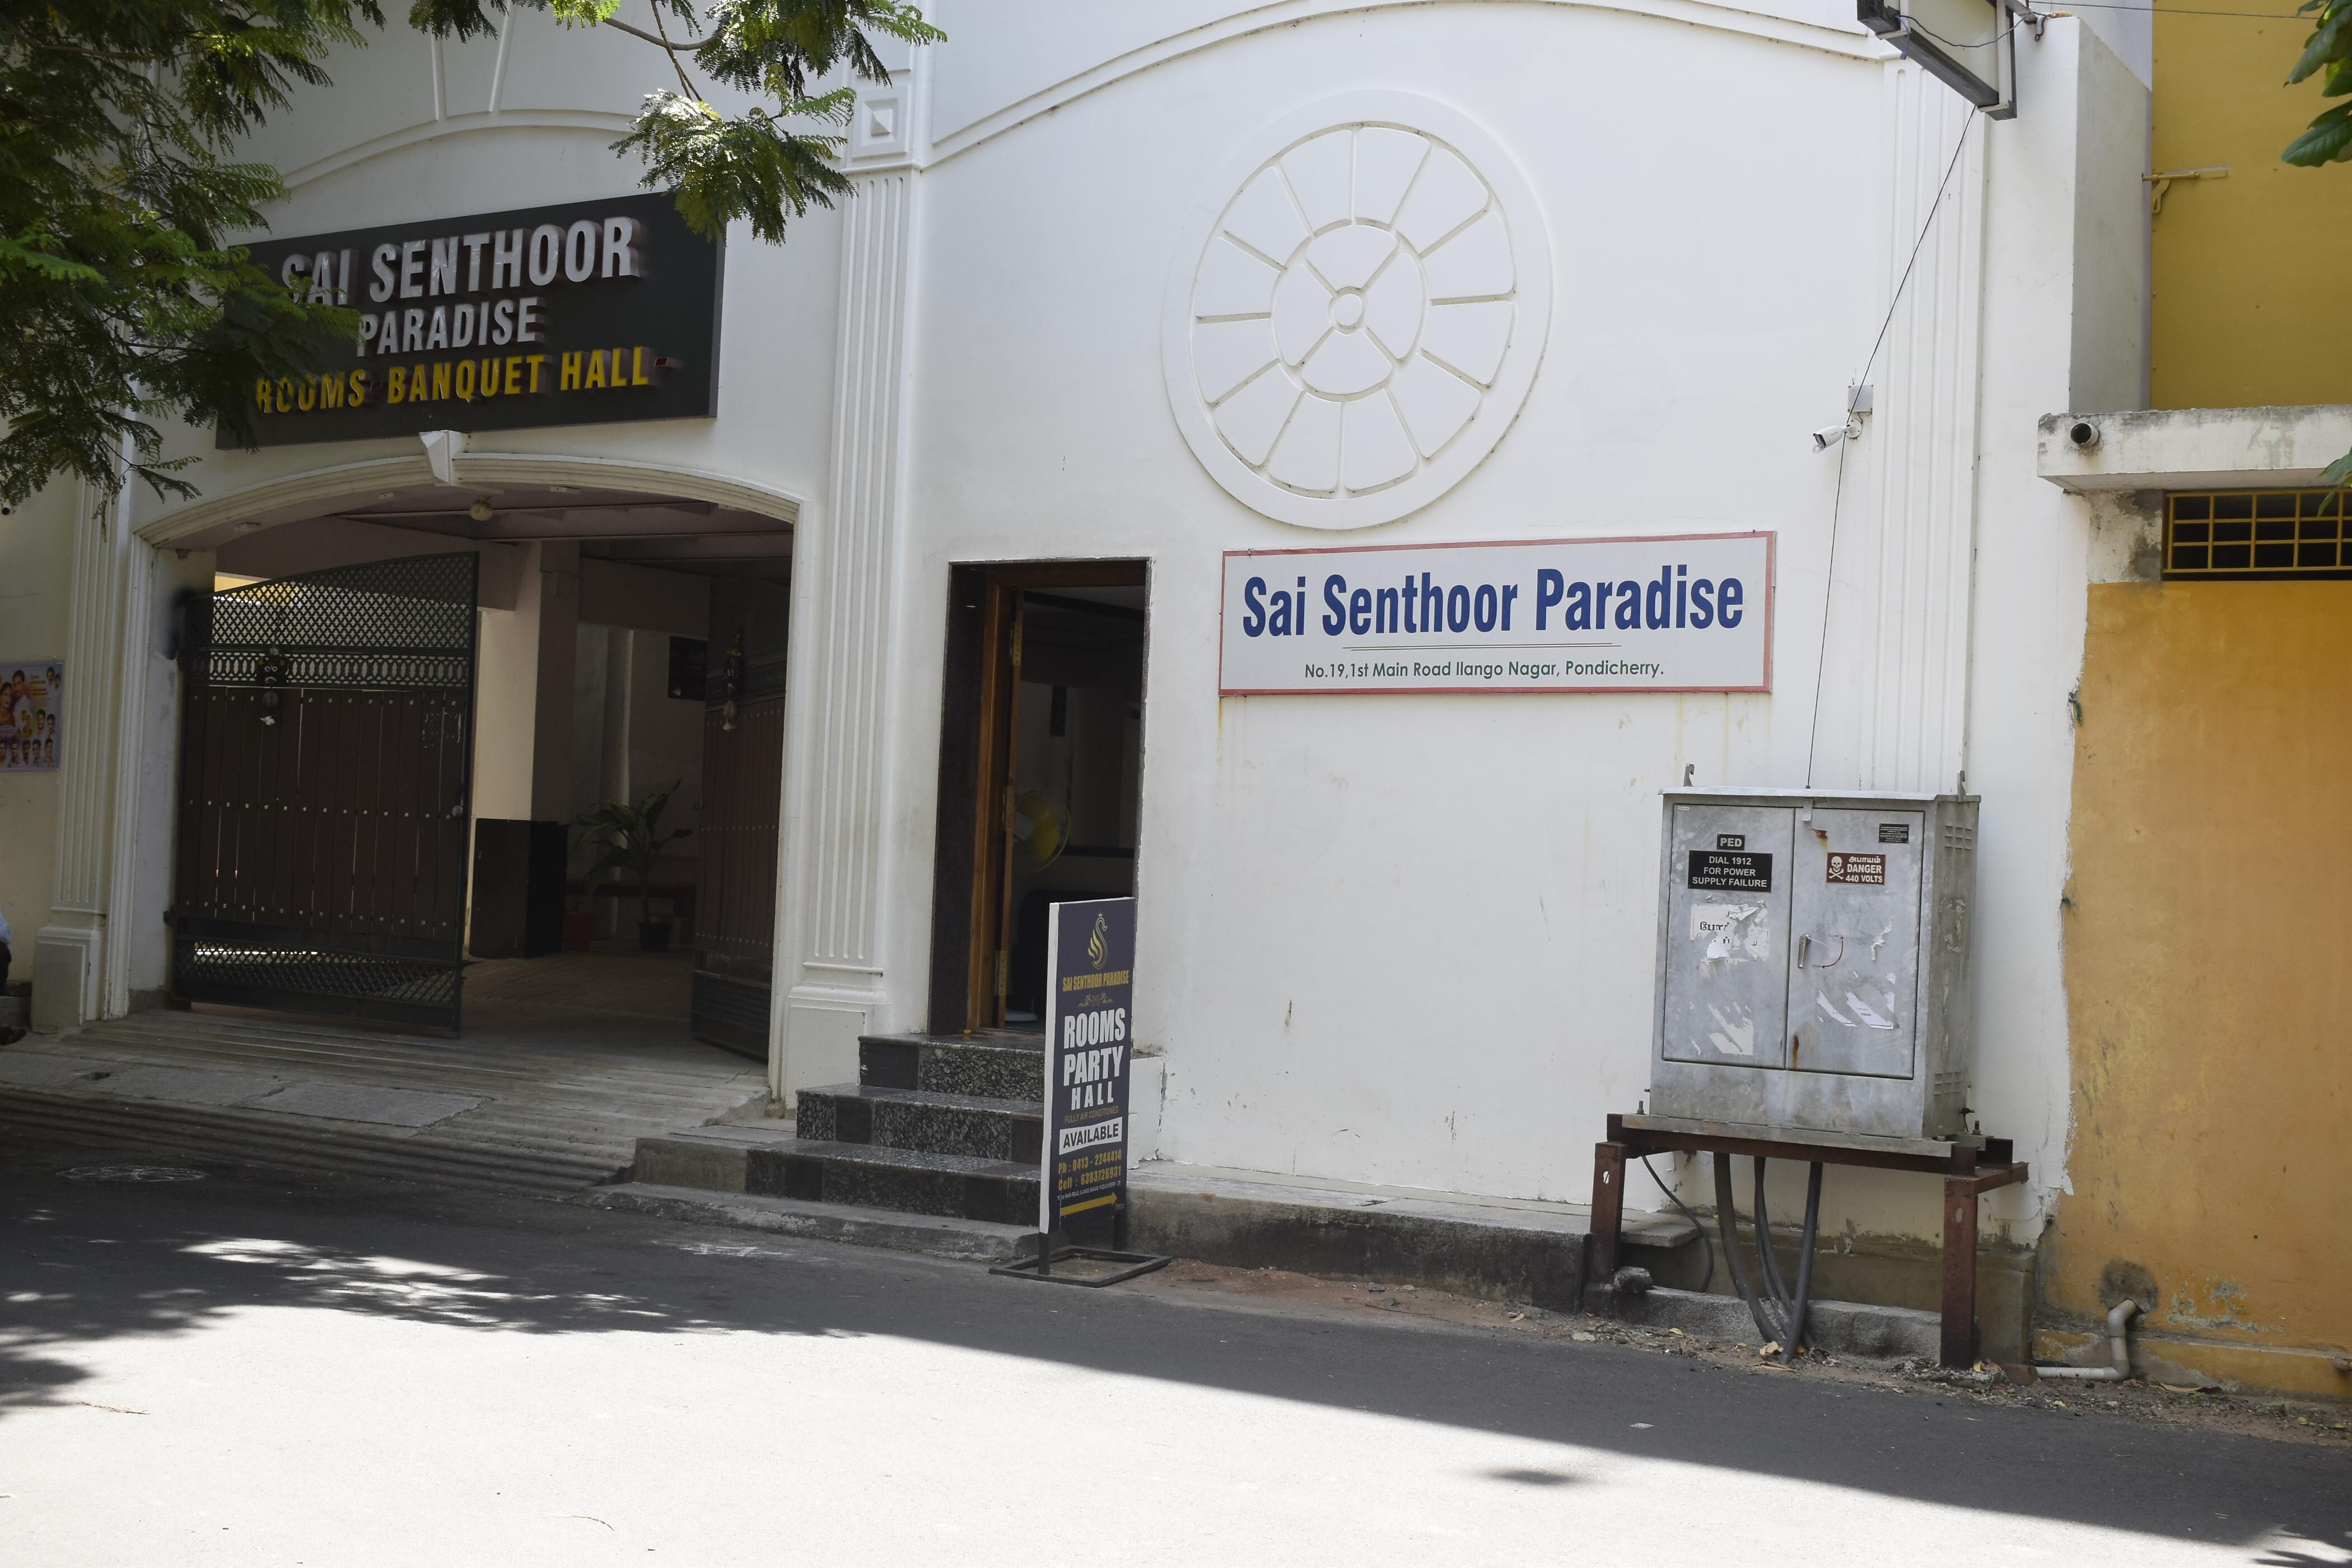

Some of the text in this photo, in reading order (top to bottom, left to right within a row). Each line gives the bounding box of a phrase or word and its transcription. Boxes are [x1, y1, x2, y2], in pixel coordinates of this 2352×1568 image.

[281, 216, 635, 306] SAI SENTHOOR
[357, 296, 539, 357] PARADISE
[255, 346, 649, 413] ROOMS BANQUET HALL
[1243, 564, 1743, 637] Sai Senthoor Paradise
[1372, 662, 1408, 677] Main
[1413, 661, 1452, 676] Road
[1455, 661, 1503, 679] Ilango
[1508, 661, 1560, 679] Nagar,
[1566, 660, 1664, 678] Pondicherry.
[1720, 837, 1742, 847] PED
[1709, 856, 1752, 865] DIAL 1912
[1724, 867, 1756, 876] POWER
[1847, 864, 1882, 874] DANGER
[1692, 876, 1767, 888] SUPPLY FAILURE
[1845, 874, 1883, 883] 440 VOLTS
[1062, 969, 1130, 992] SAI SENTHOOR PARADISE
[1064, 1007, 1126, 1049] ROOMS
[1063, 1045, 1124, 1086] PARTY
[1071, 1081, 1114, 1110] HALL
[1063, 1123, 1119, 1148] AVAILABLE
[1058, 1161, 1067, 1174] Ph
[1072, 1156, 1089, 1171] 0413
[1095, 1149, 1122, 1165] 2244414
[1058, 1177, 1072, 1191] Cell
[1080, 1165, 1121, 1186] 6383726931
